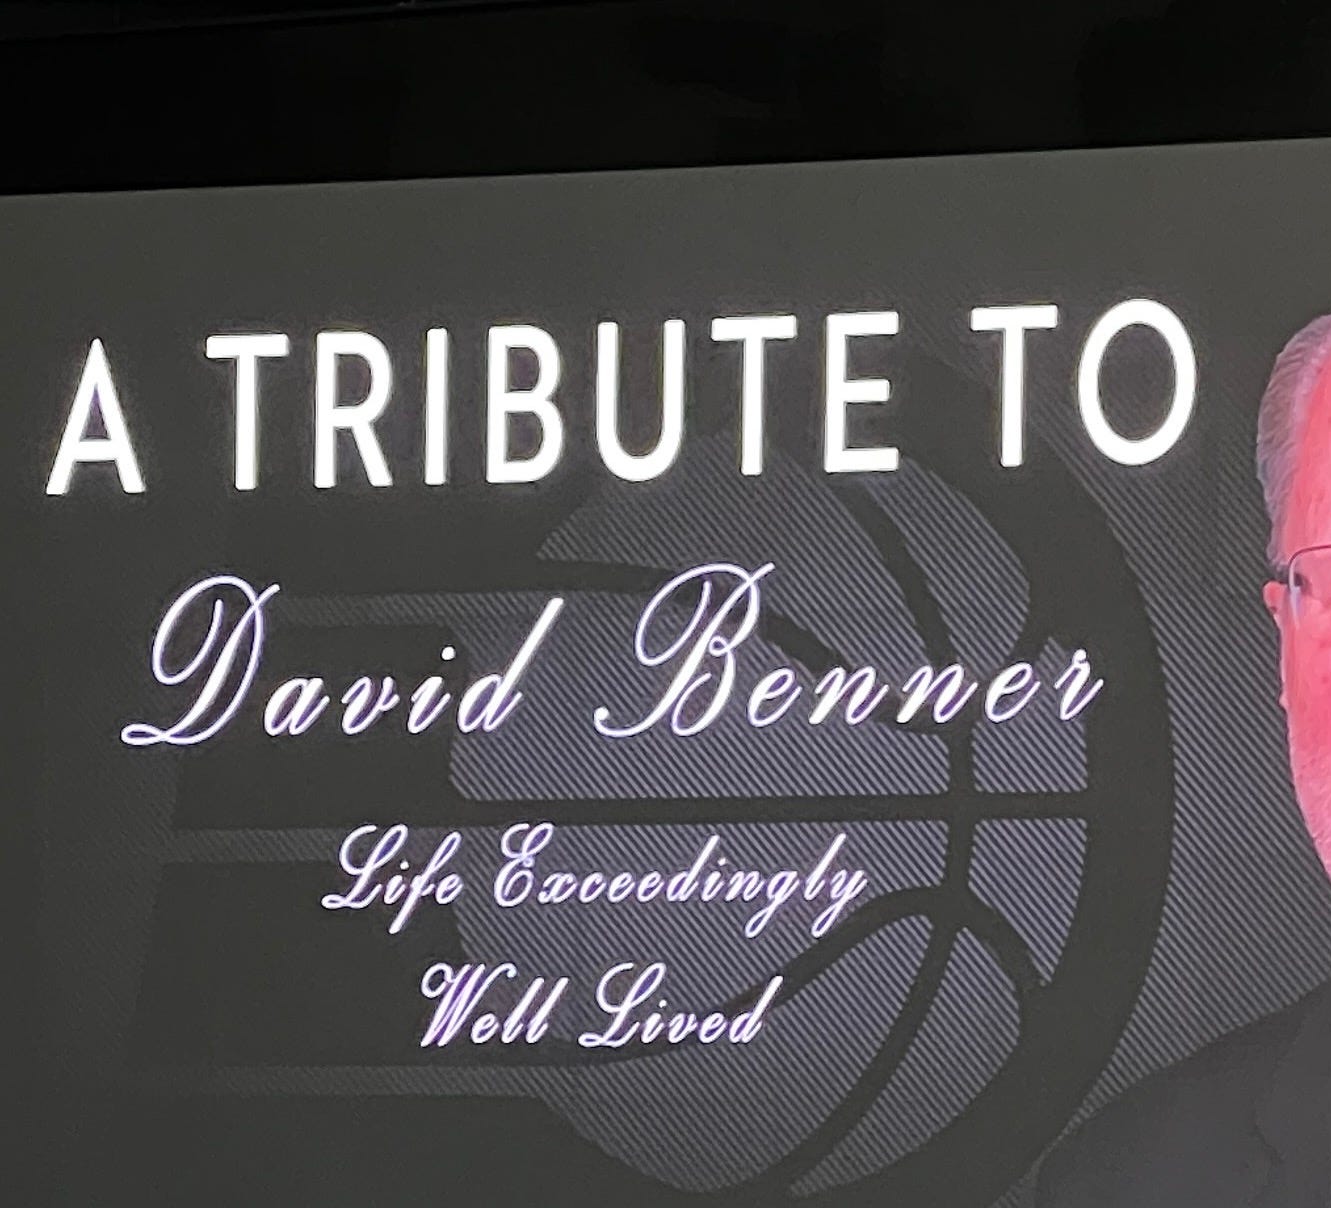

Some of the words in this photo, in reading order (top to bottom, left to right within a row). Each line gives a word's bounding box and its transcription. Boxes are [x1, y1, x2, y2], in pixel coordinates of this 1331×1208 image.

[44, 337, 147, 496] A
[205, 310, 900, 492] TRIBUTE
[969, 297, 1198, 469] TO
[120, 574, 565, 747] David
[592, 561, 1105, 739] Benner
[320, 823, 465, 935] Life
[493, 822, 869, 939] Exceedingly
[419, 961, 570, 1048] Well
[577, 961, 785, 1049] Lived
